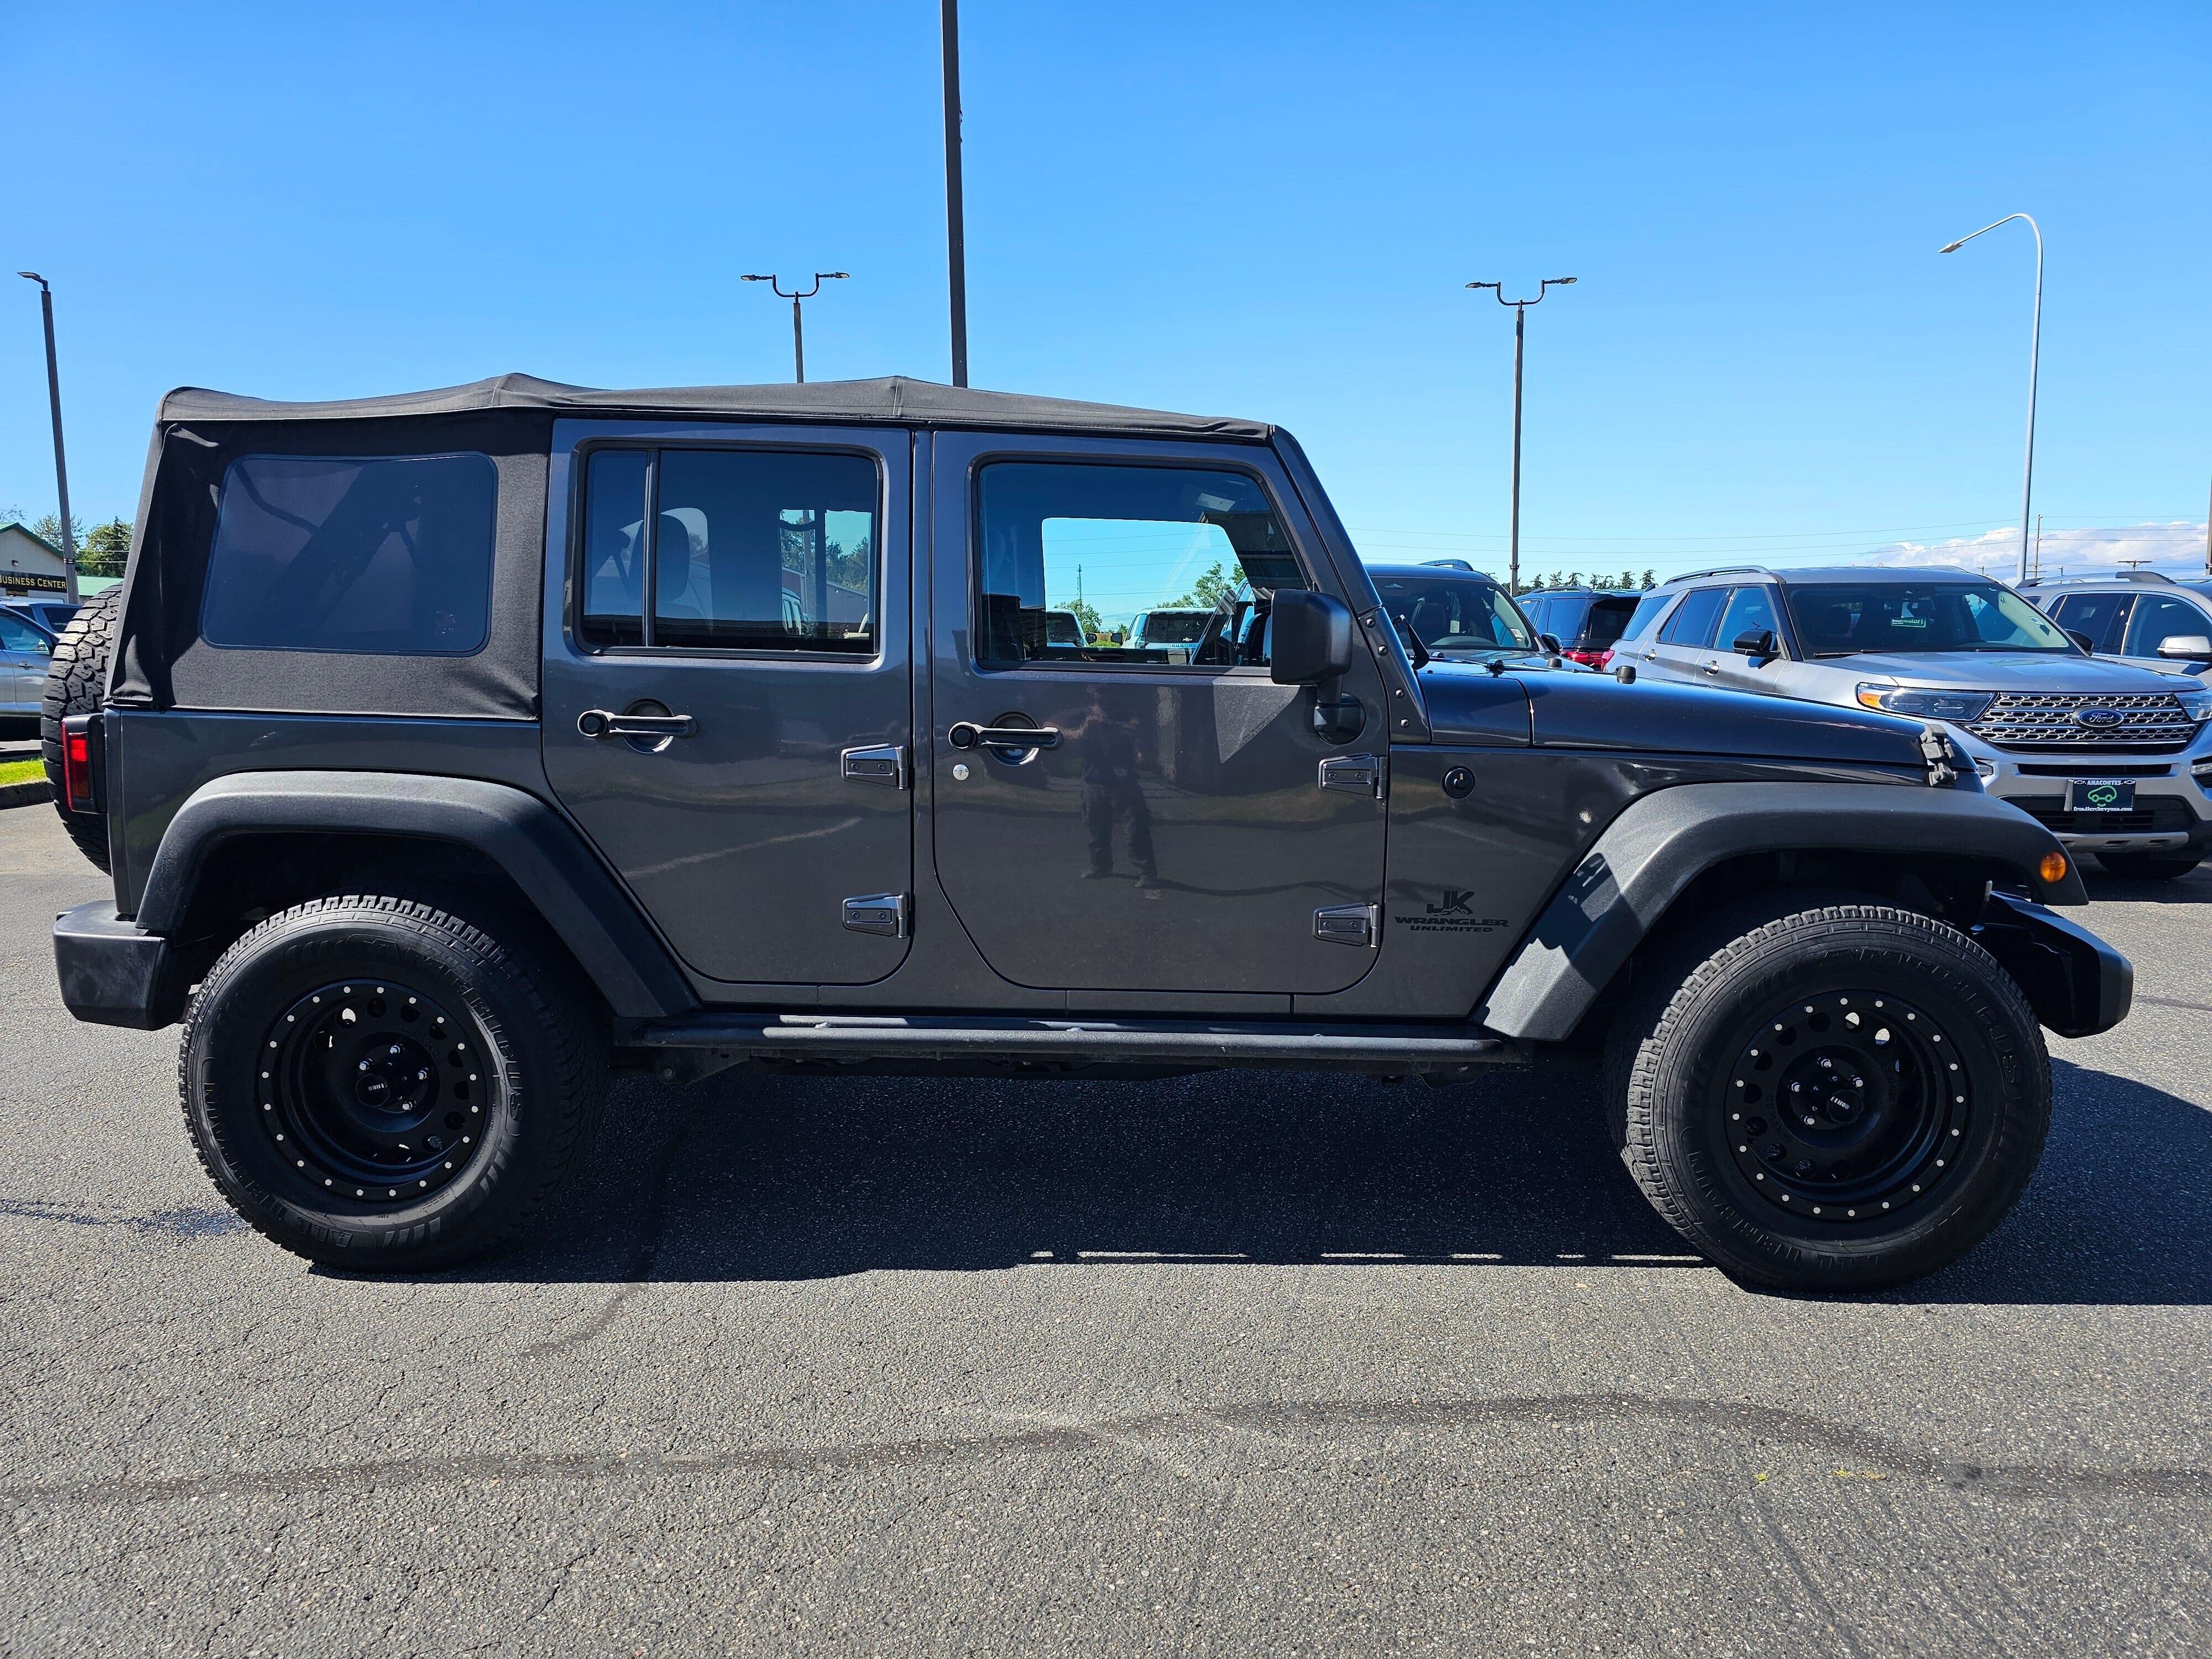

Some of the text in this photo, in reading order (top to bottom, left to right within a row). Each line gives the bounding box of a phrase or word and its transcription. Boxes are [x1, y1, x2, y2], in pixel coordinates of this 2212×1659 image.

[37, 578, 66, 589] CENTER
[2089, 712, 2114, 723] Ford
[1426, 890, 1475, 915] JK
[1394, 916, 1509, 927] WRANGLER
